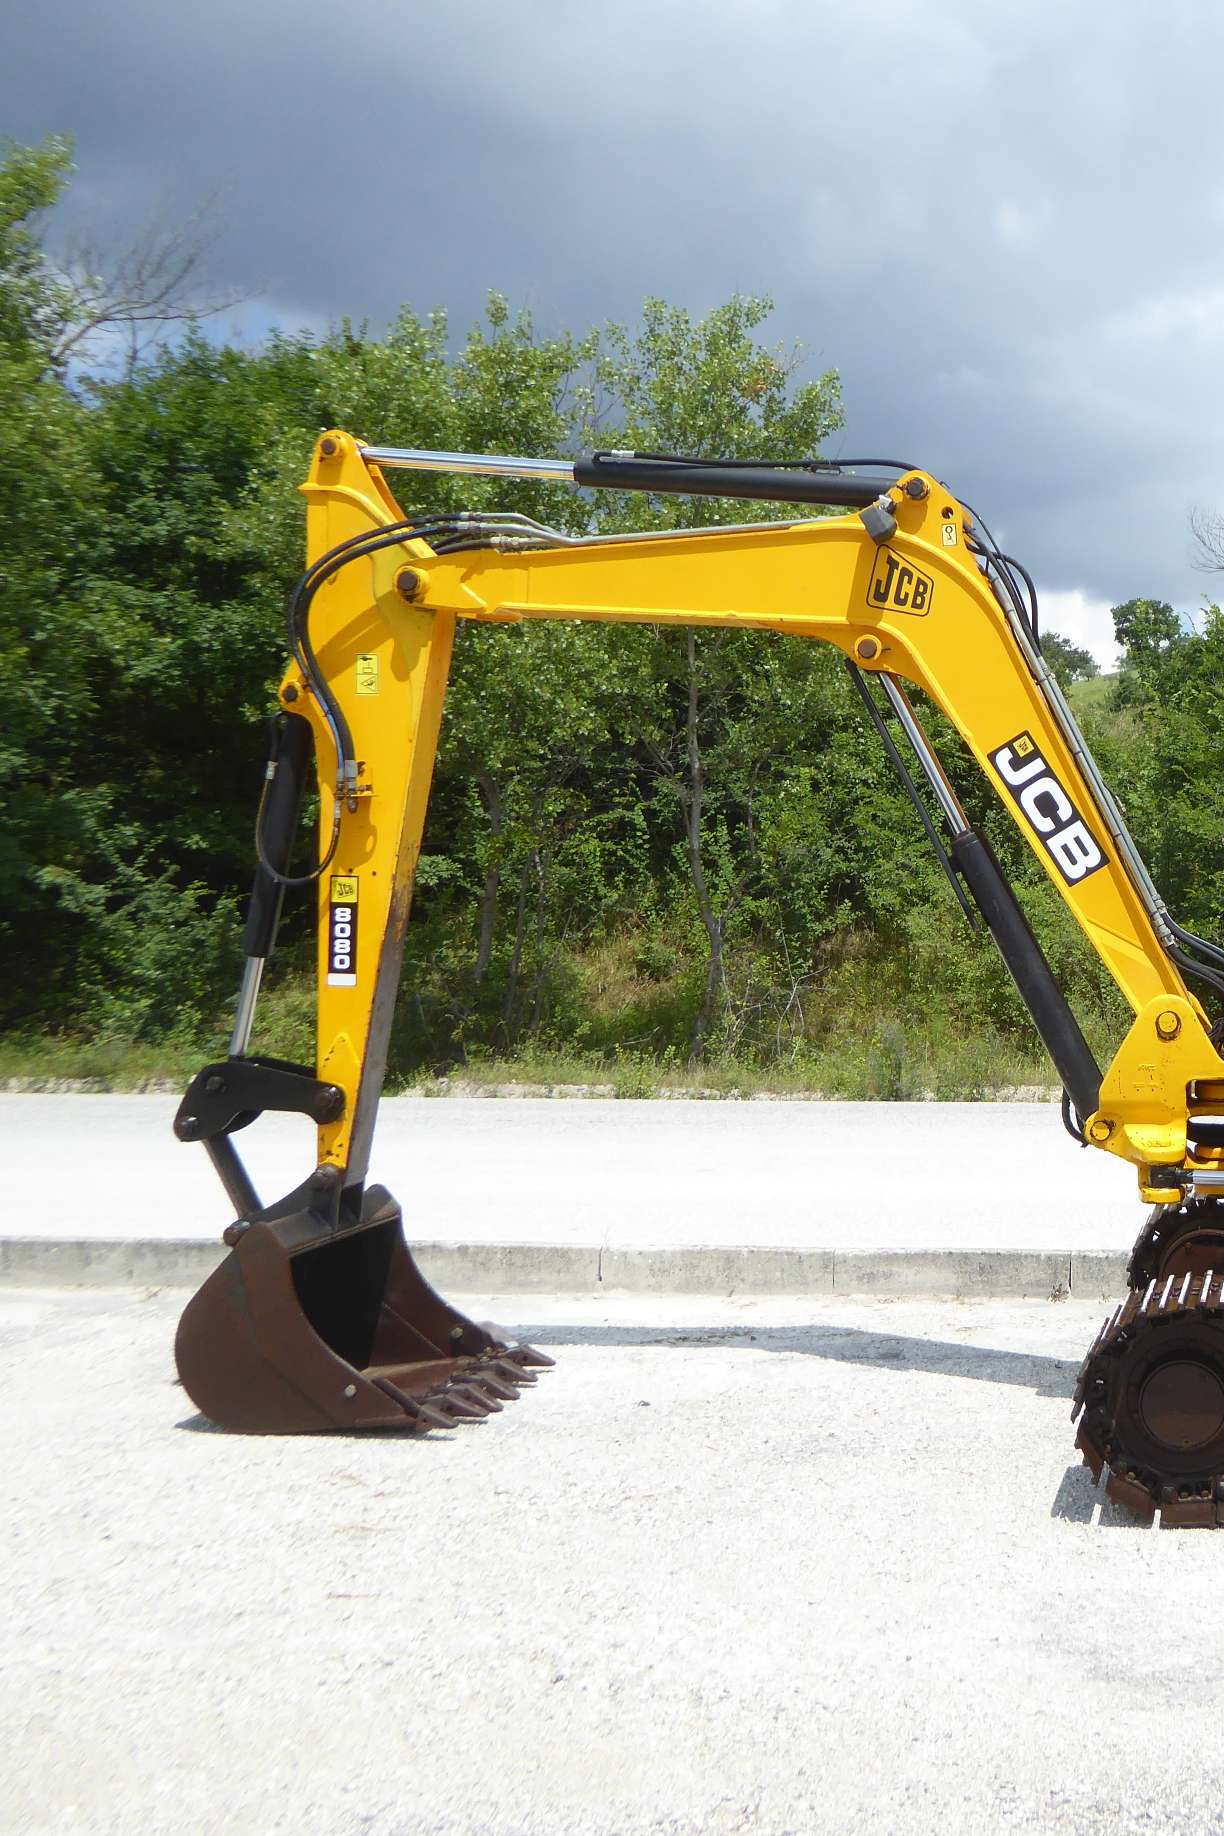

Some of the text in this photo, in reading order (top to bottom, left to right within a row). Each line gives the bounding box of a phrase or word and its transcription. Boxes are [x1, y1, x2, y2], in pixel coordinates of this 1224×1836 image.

[874, 554, 929, 609] JCB
[995, 747, 1102, 879] JCB
[333, 907, 352, 970] 8080
